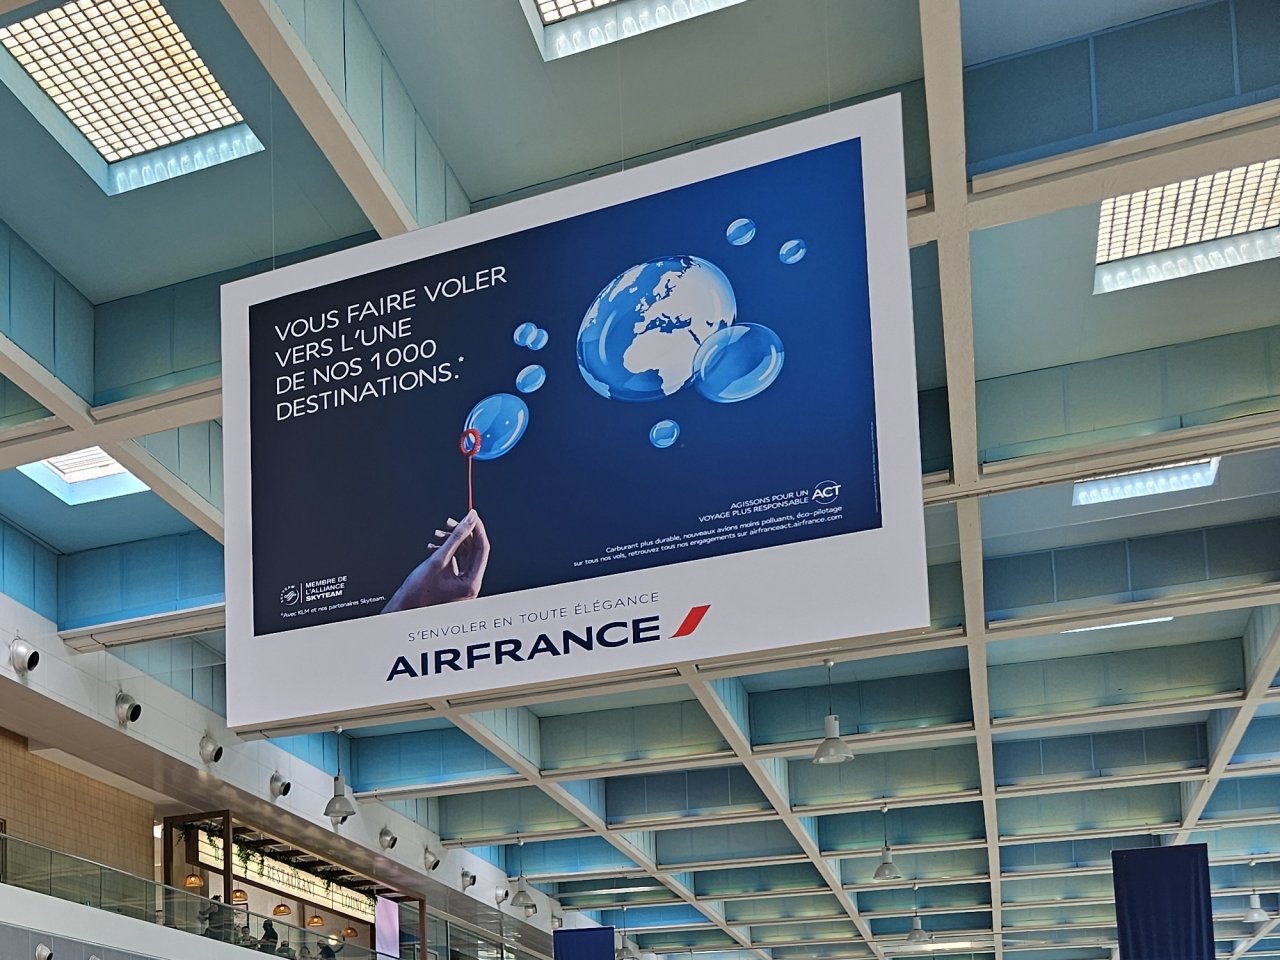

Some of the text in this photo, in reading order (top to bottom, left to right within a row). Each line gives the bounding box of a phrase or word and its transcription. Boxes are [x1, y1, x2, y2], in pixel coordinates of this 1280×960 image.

[275, 266, 507, 341] VOUS FAIRE VOLER
[275, 317, 412, 367] VERS L'UNE
[276, 339, 436, 395] DE NOS 1000
[698, 497, 809, 523] VOYAGE PLUS RESPONSABLE
[730, 497, 771, 510] AGISSONS
[772, 492, 794, 501] POUR
[812, 485, 841, 500] ACT
[606, 543, 639, 553] Carburant
[655, 535, 681, 544] durable,
[683, 529, 715, 539] nouveaux
[717, 525, 738, 533] avions
[740, 521, 760, 529] moins
[761, 514, 795, 527] polluants,
[796, 506, 842, 519] éco-pilotage
[628, 547, 659, 557] retrouvez
[690, 532, 736, 547] engagements
[750, 514, 842, 535] airfranceact.airfrance.com
[306, 577, 336, 588] MEMBRE
[306, 590, 342, 601] SKYTEAM
[408, 591, 660, 642] S'ENVOLER EN TOUTE ÉLÉGANCE
[386, 615, 660, 681] AIRFRANCE
[267, 862, 316, 897] RESTAURANT
